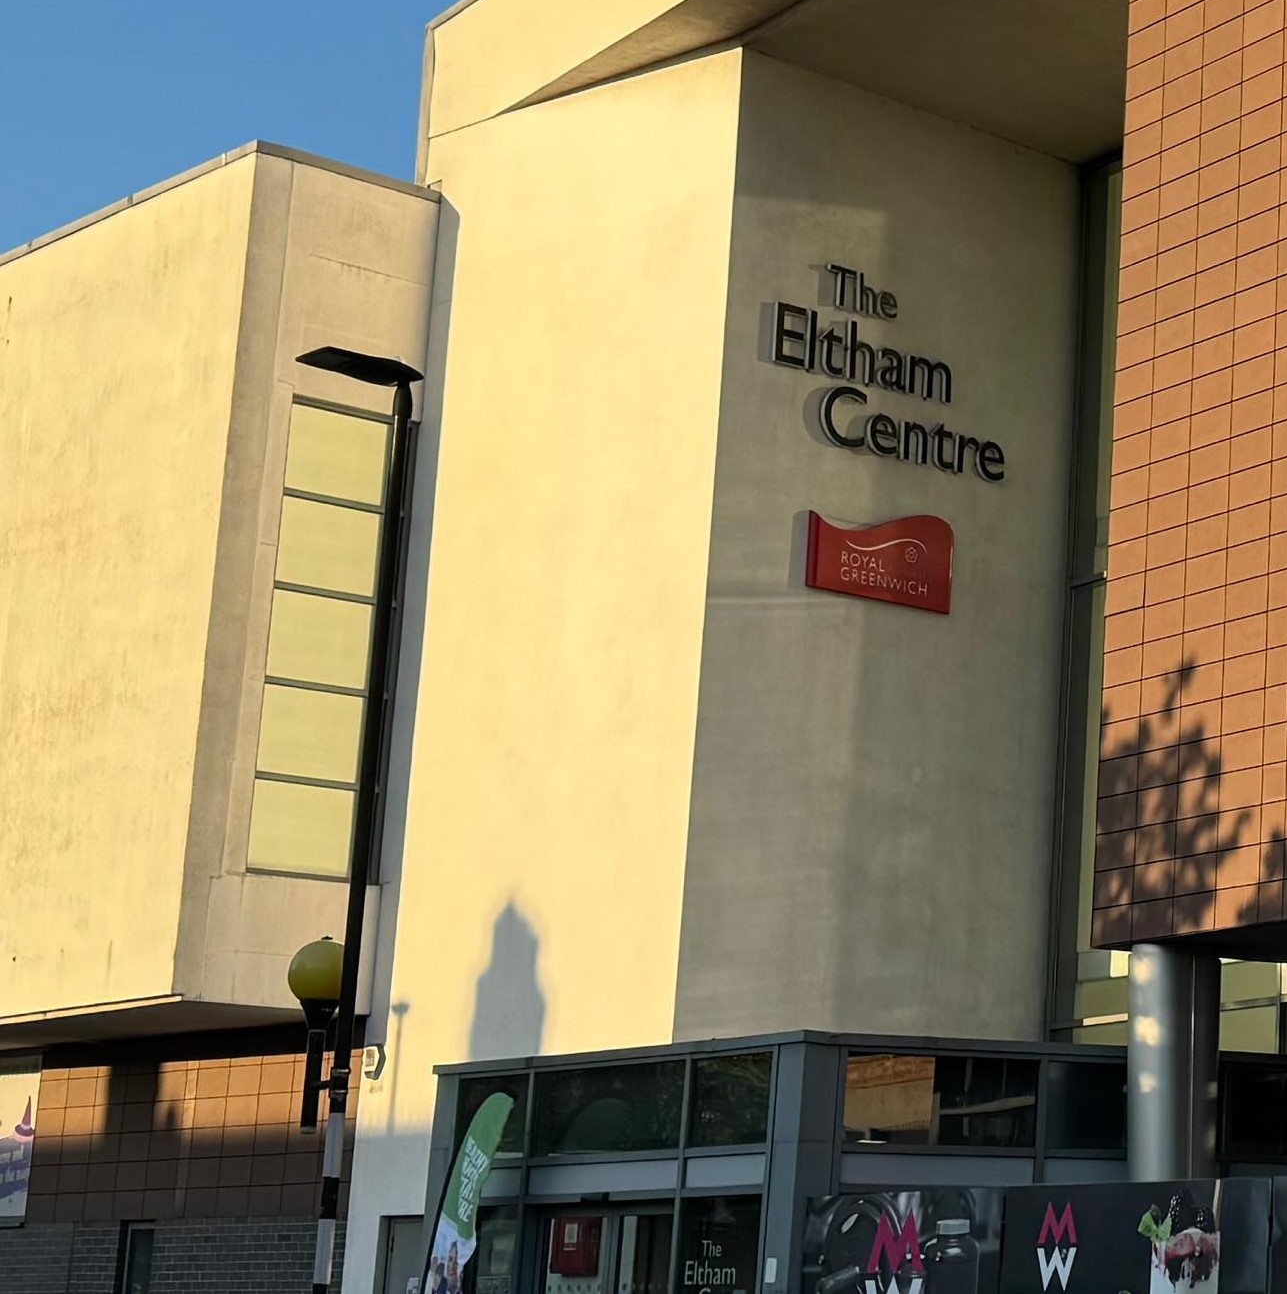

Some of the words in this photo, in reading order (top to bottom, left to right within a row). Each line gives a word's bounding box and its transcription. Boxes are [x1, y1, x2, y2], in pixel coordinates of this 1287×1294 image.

[826, 263, 898, 320] The
[772, 301, 953, 404] Eltham
[820, 386, 1005, 483] Centre
[840, 550, 886, 573] ROYAL
[840, 567, 928, 597] GREENWICH
[701, 1239, 723, 1258] The
[684, 1259, 736, 1286] Eltham
